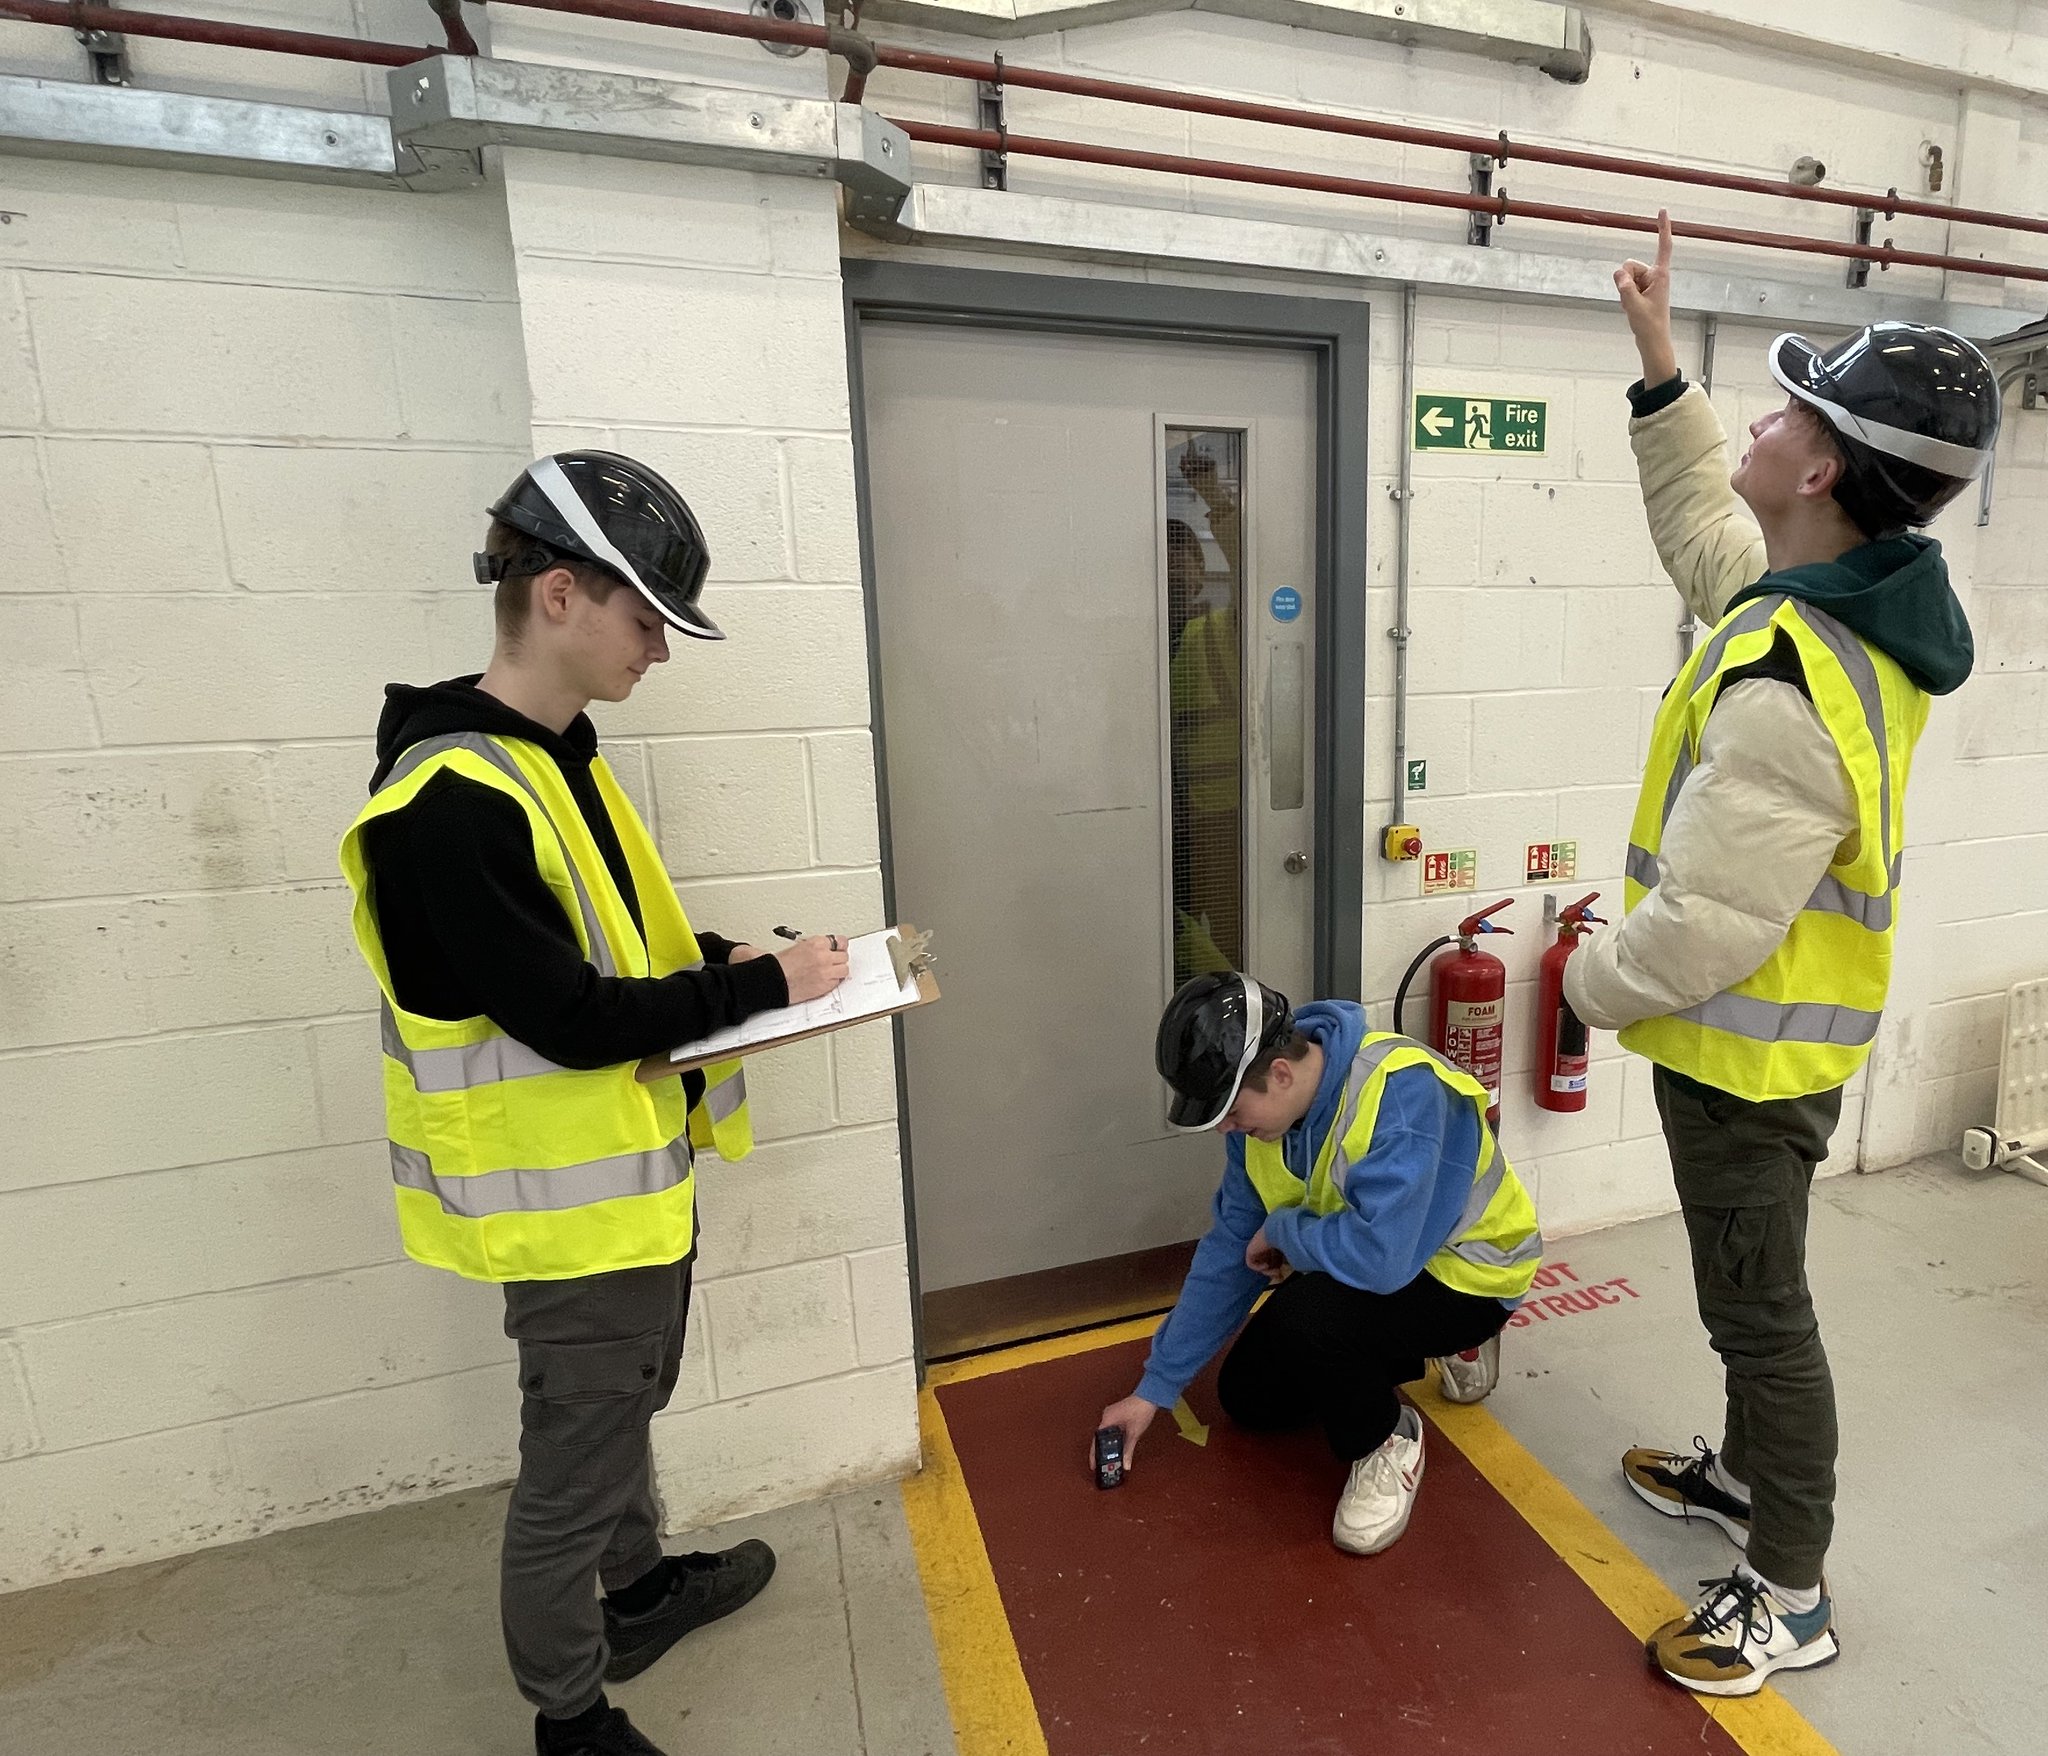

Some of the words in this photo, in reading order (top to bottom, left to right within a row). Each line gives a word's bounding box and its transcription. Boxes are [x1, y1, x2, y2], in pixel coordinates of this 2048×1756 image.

[1505, 403, 1539, 424] Fire
[1504, 429, 1538, 448] exit
[1467, 1004, 1495, 1016] FOAM
[1446, 1027, 1457, 1063] POW
[1502, 1278, 1640, 1328] STRUCT
